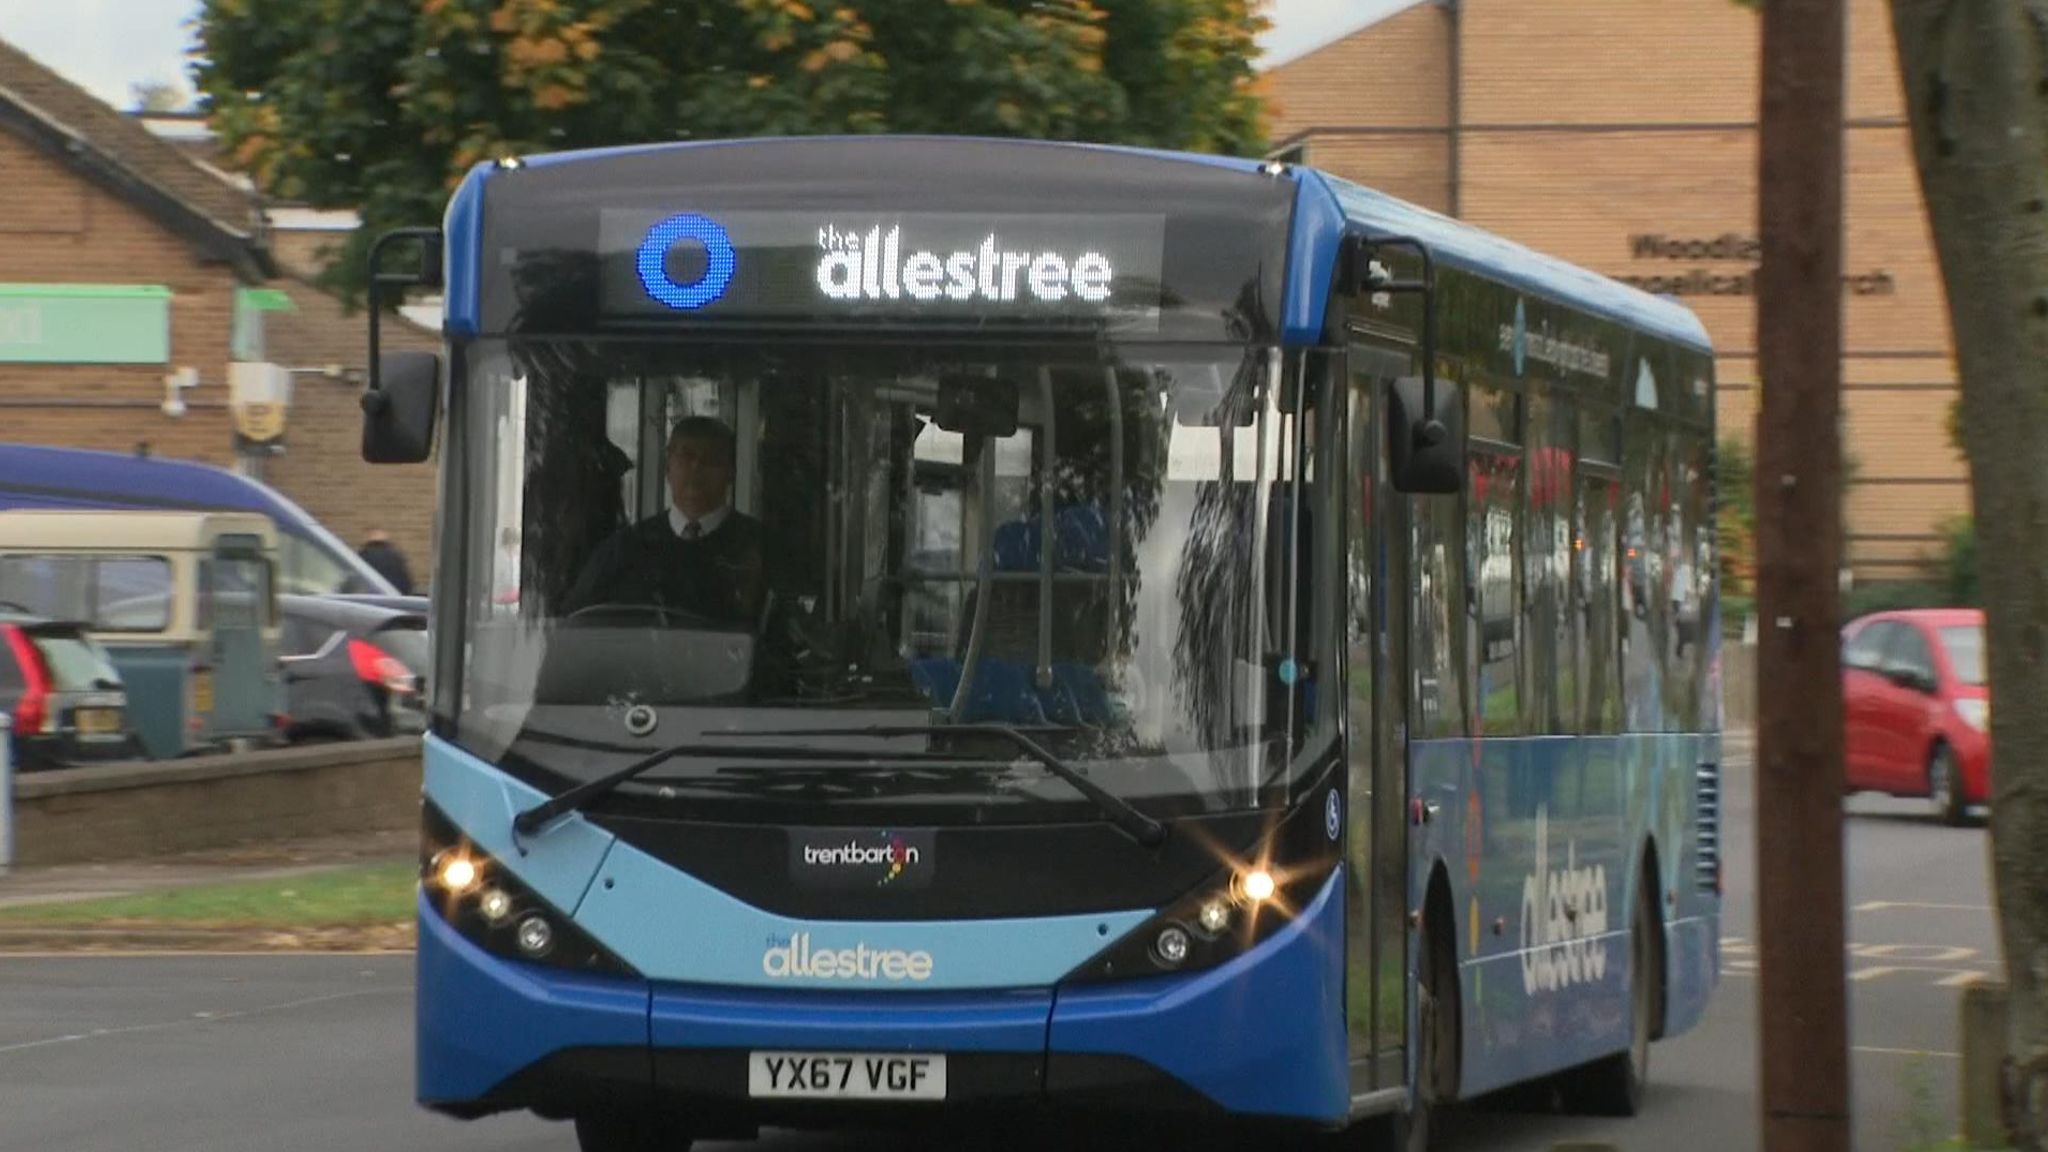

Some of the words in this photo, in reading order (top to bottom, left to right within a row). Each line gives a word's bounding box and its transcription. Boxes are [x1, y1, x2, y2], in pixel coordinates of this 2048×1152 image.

[818, 222, 859, 251] the
[1627, 234, 1761, 260] Woodla
[816, 224, 1112, 301] allestree
[804, 840, 919, 864] trentbarton
[763, 931, 934, 980] allestree
[765, 1057, 853, 1092] YX67
[865, 1058, 930, 1092] VGF
